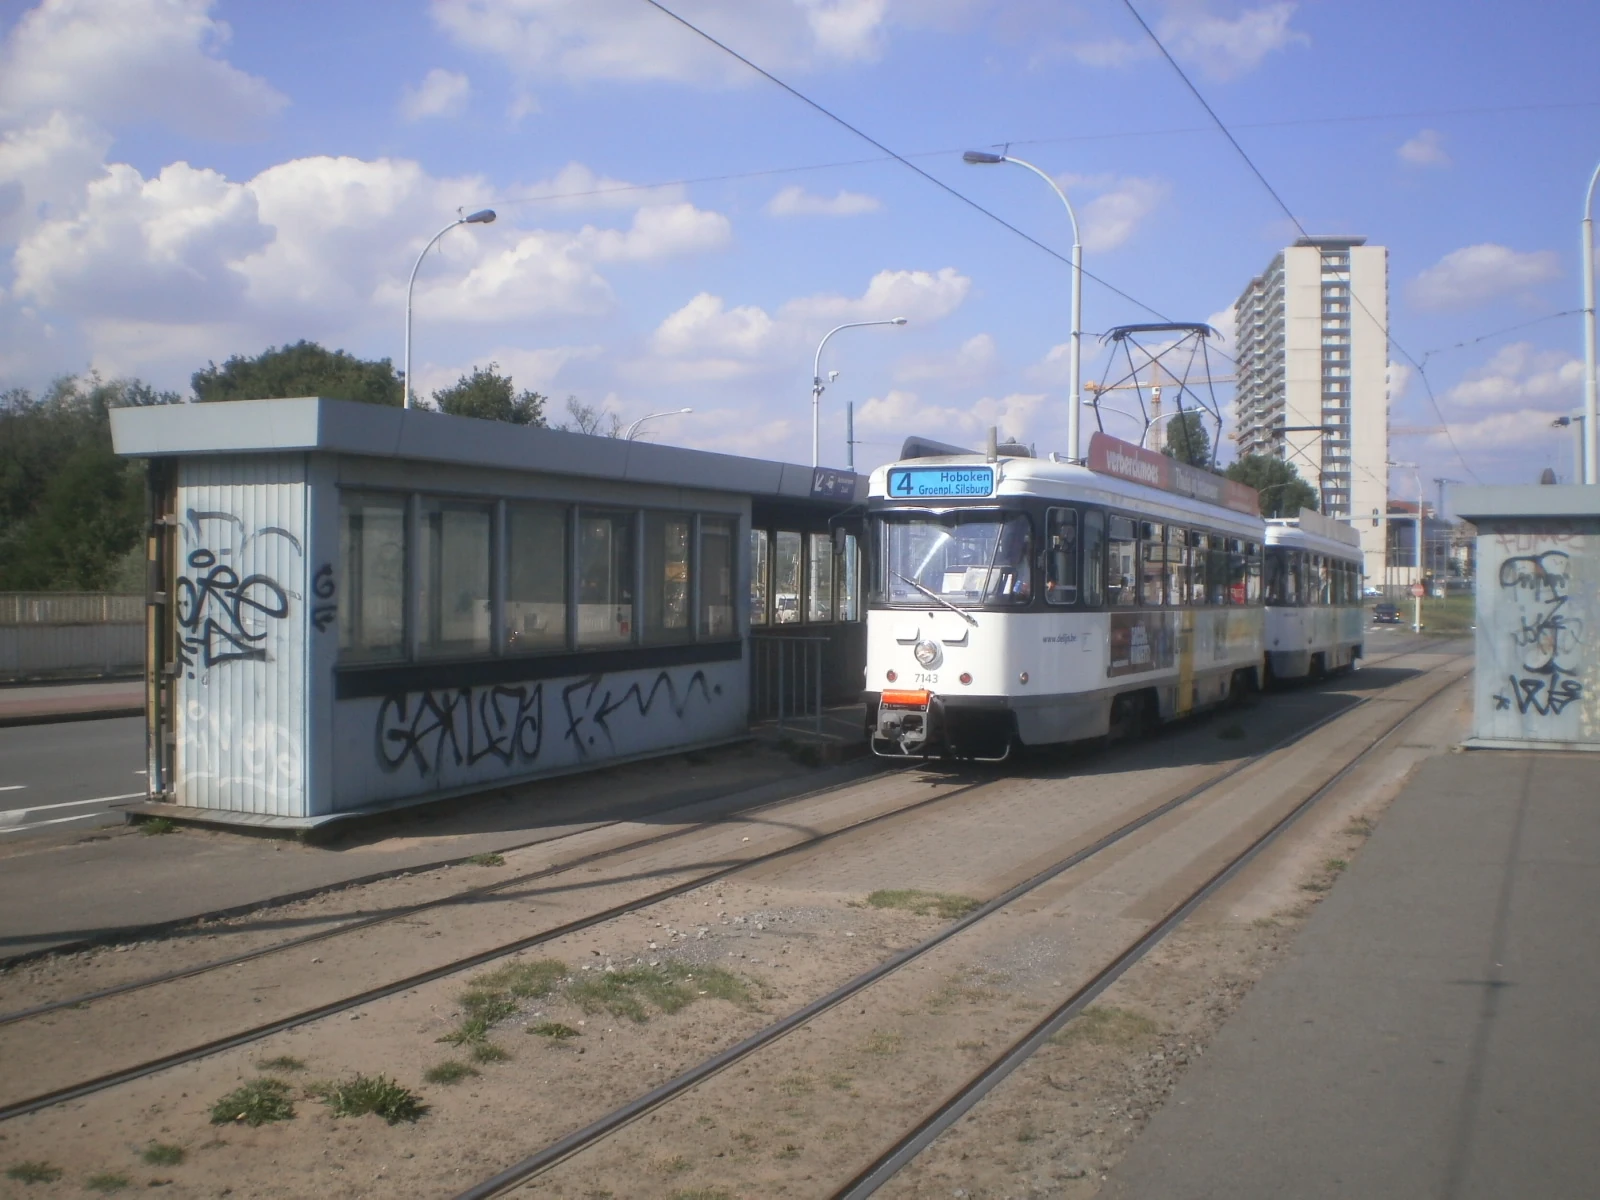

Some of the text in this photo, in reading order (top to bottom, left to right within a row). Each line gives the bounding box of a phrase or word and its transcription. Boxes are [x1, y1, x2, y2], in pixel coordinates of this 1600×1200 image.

[940, 471, 990, 482] Hoboken
[896, 472, 914, 495] 4
[918, 484, 989, 495] Groenpl. Silsburg
[914, 673, 938, 684] 7143
